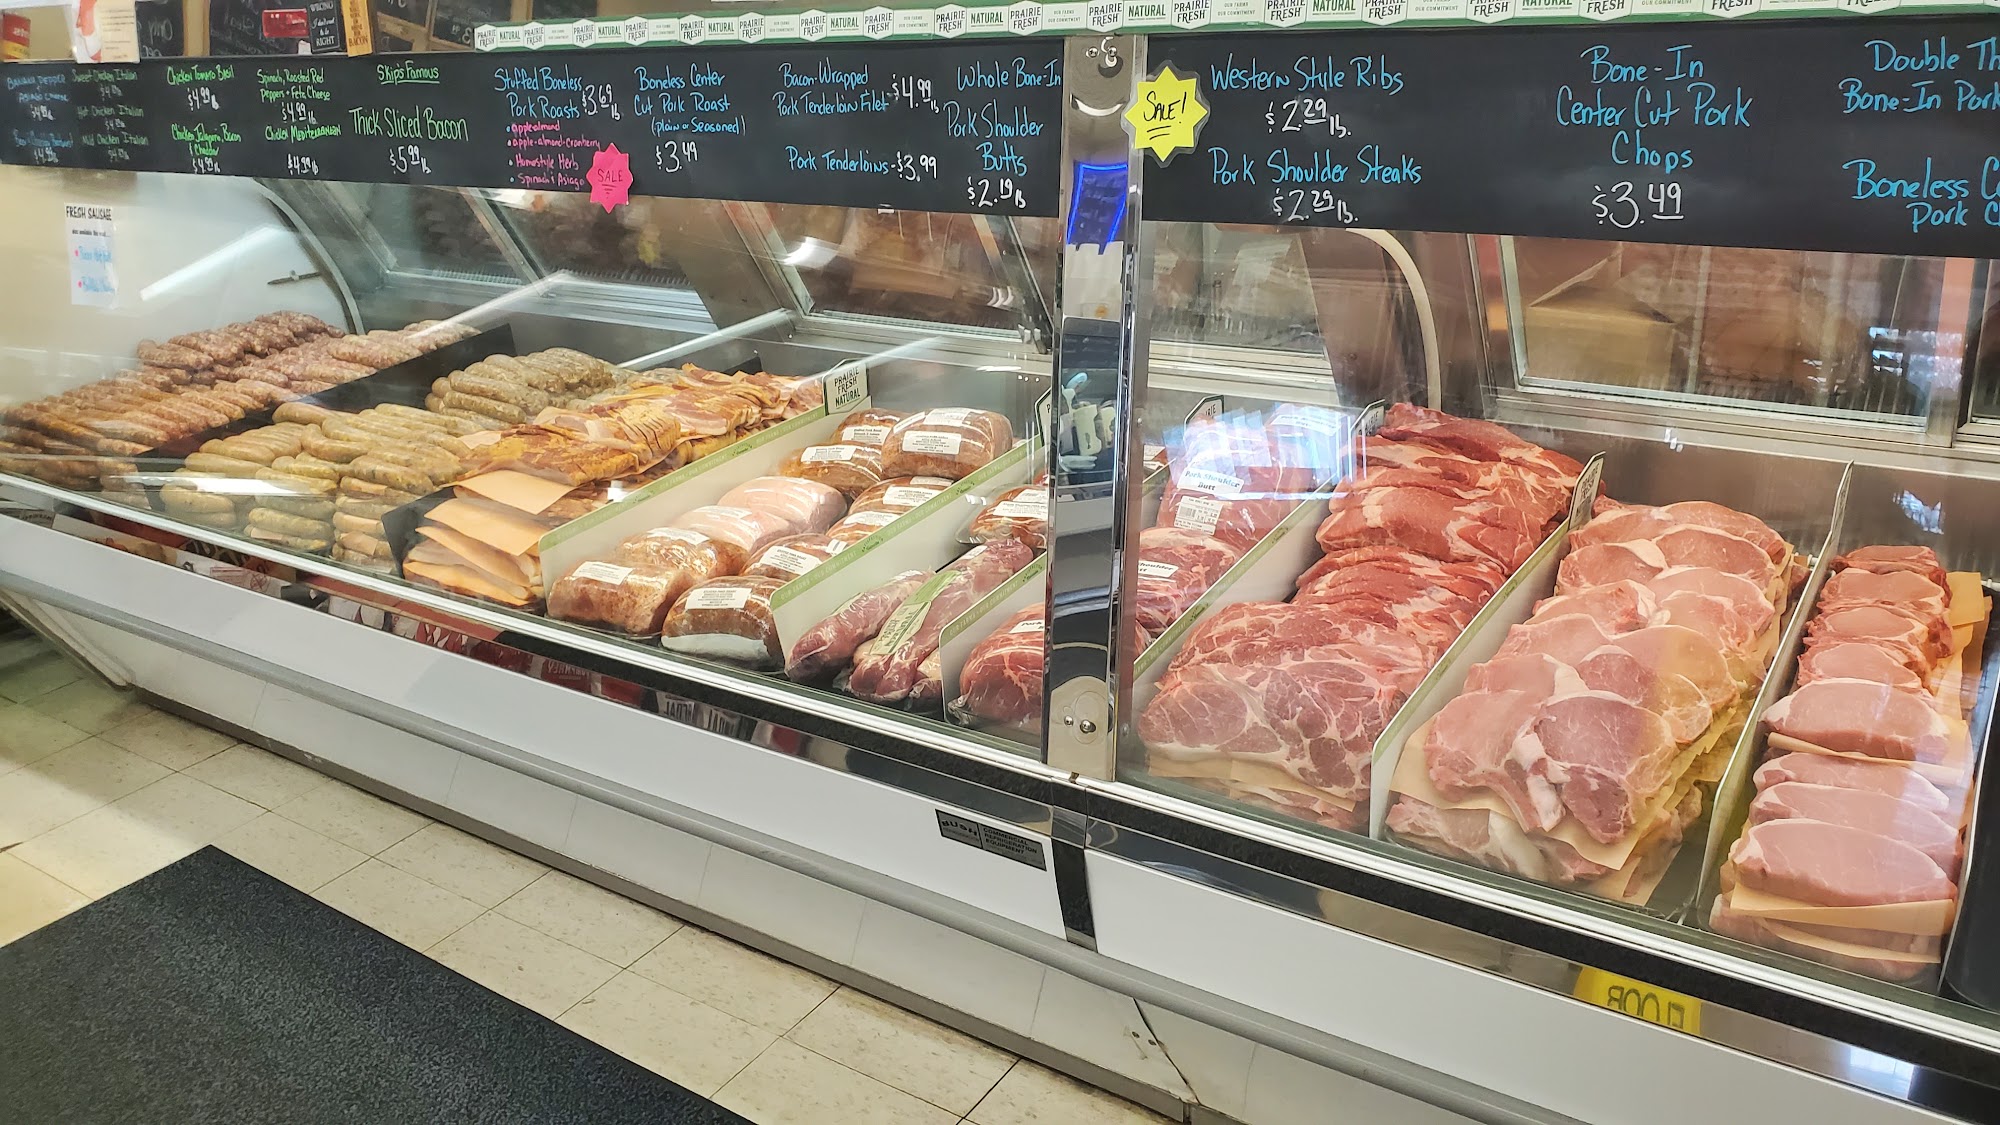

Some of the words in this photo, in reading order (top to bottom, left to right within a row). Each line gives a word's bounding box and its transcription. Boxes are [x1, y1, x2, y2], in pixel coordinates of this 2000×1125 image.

[1010, 6, 1040, 19] PRAIRIE
[1088, 2, 1122, 16] PRAIRIE
[1128, 4, 1165, 18] NATURAL
[1173, 0, 1209, 12] PRAIRIE
[1271, 7, 1301, 21] FRESH
[1312, 0, 1356, 11] NATURAL
[1368, 5, 1401, 19] FRESH
[1473, 2, 1509, 17] FRESH
[739, 17, 764, 29] PRAIRIE
[801, 15, 826, 27] PRAIRIE
[830, 17, 859, 28] NATURAL
[865, 12, 892, 25] PRAIRIE
[936, 10, 965, 23] PRAIRIE
[970, 11, 1003, 24] NATURAL
[1013, 17, 1038, 30] FRESH
[1091, 13, 1118, 27] FRESH
[1177, 10, 1205, 23] FRESH
[681, 20, 704, 32] PRAIRIE
[683, 29, 702, 40] FRESH
[708, 21, 734, 33] NATURAL
[742, 27, 762, 39] FRESH
[804, 25, 824, 36] FRESH
[868, 22, 889, 34] FRESH
[938, 20, 962, 33] FRESH
[316, 36, 335, 47] RIGHT
[1864, 36, 1960, 72] Double
[167, 66, 192, 86] Chicken
[284, 68, 310, 83] Roasted
[310, 67, 325, 84] Red
[404, 60, 440, 80] Famous
[494, 66, 539, 91] Stuffed
[538, 63, 583, 91] Boneless
[634, 65, 686, 91] Boneless
[689, 62, 726, 88] Center
[957, 61, 1009, 91] Whole
[1011, 57, 1061, 89] Bone-In
[1210, 53, 1290, 90] Western
[1293, 55, 1344, 91] Style
[1350, 54, 1405, 96] Ribs
[291, 85, 307, 100] Feta
[307, 86, 331, 102] Cheese
[1838, 77, 1942, 114] Bone-In
[506, 92, 538, 118] Pork
[537, 95, 580, 119] Roasts
[634, 94, 654, 116] Cut
[659, 92, 686, 114] Pork
[689, 92, 731, 113] Roast
[772, 91, 800, 117] Pork
[800, 91, 859, 115] Tenderloin
[1556, 85, 1628, 127] Center
[1634, 85, 1681, 128] Cut
[1687, 82, 1753, 128] Pork
[349, 107, 383, 136] Thick
[383, 105, 423, 139] Sliced
[423, 107, 469, 142] Bacon
[943, 100, 979, 136] Pork
[980, 99, 1044, 139] Shoulder
[785, 146, 818, 171] Pork
[821, 148, 889, 174] Tenderloins
[976, 140, 1028, 176] Butts
[1612, 129, 1695, 175] Chops
[558, 152, 579, 171] Herb
[1208, 147, 1257, 185] Pork
[1266, 146, 1349, 185] Shoulder
[1356, 144, 1423, 185] Steaks
[517, 172, 550, 187] Spinach
[557, 174, 585, 191] Asiago
[597, 168, 623, 183] SALE
[1842, 157, 1970, 200] Boneless
[66, 206, 87, 219] FRESH
[87, 207, 112, 221] SAUSAGE
[1906, 201, 1969, 234] Pork
[834, 366, 860, 387] PRAIRIE
[837, 376, 858, 395] FRESH
[835, 387, 861, 407] NATURAL
[1185, 470, 1201, 479] Pork
[1205, 474, 1241, 488] Shoulder
[1197, 482, 1216, 491] Butt
[983, 828, 1029, 847] COMMERCIAL
[985, 833, 1038, 855] REFRIGERATION
[986, 838, 1025, 855] EQUIPMENT
